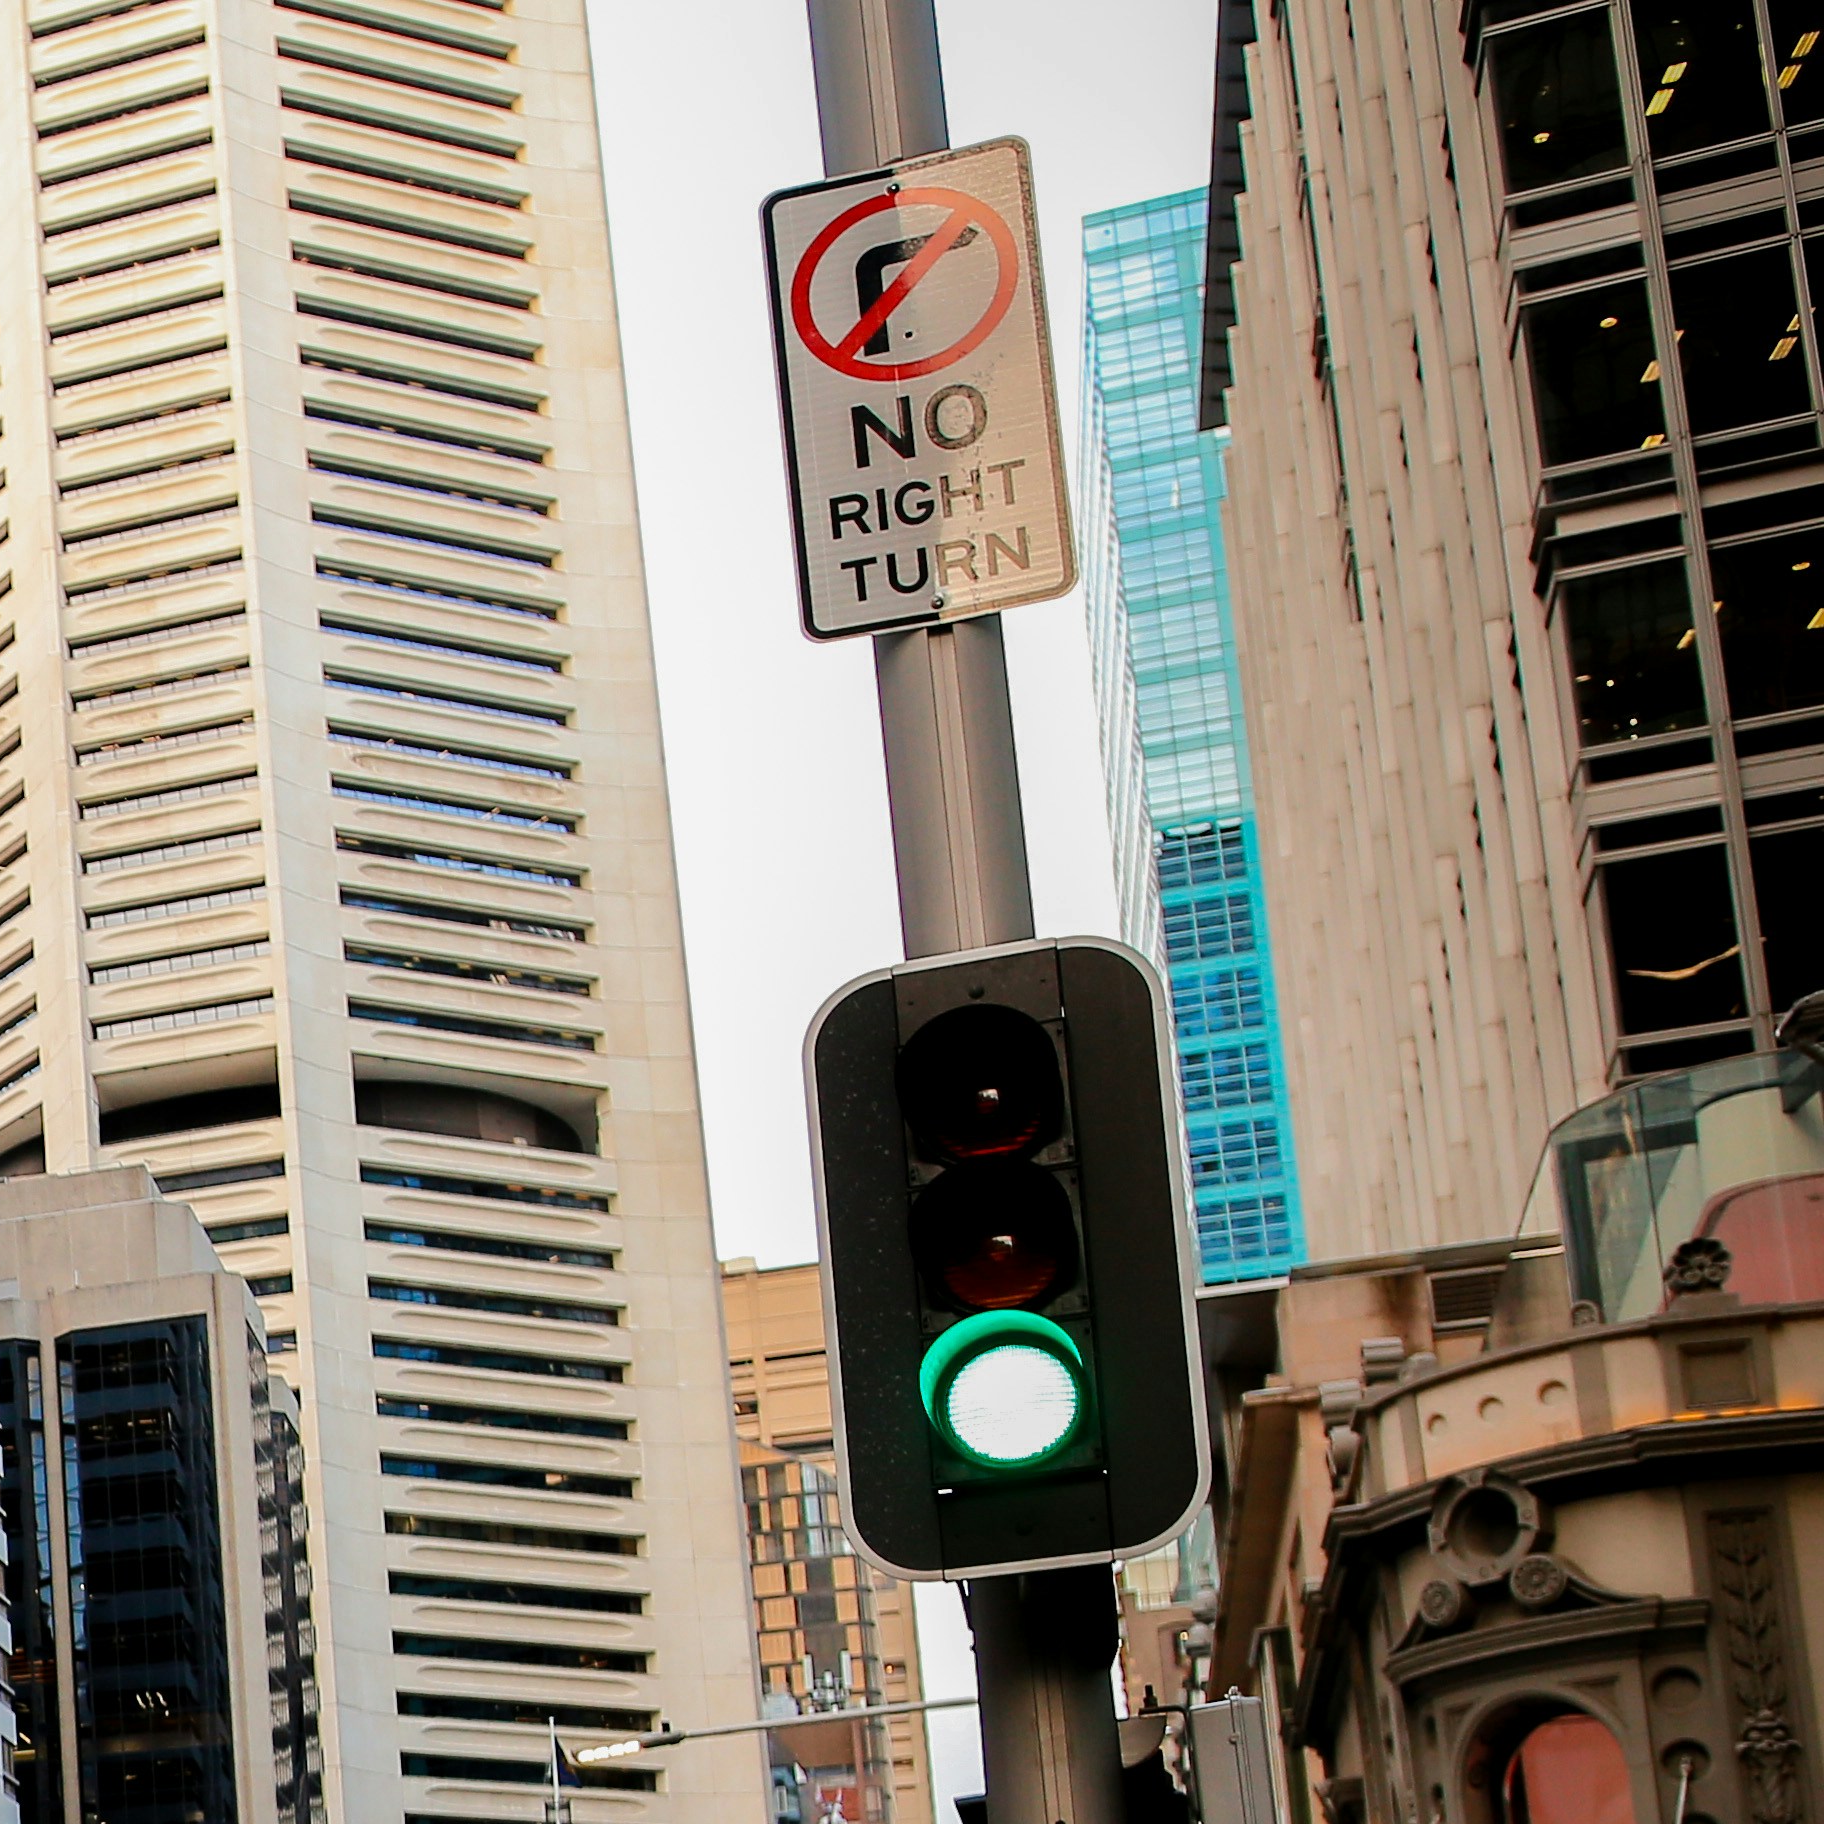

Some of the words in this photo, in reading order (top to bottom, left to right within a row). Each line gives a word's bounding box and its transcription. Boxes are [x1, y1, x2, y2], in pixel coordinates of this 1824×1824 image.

[852, 383, 988, 468] NO
[829, 458, 1026, 540] RIGHT
[840, 527, 1032, 602] TURN
